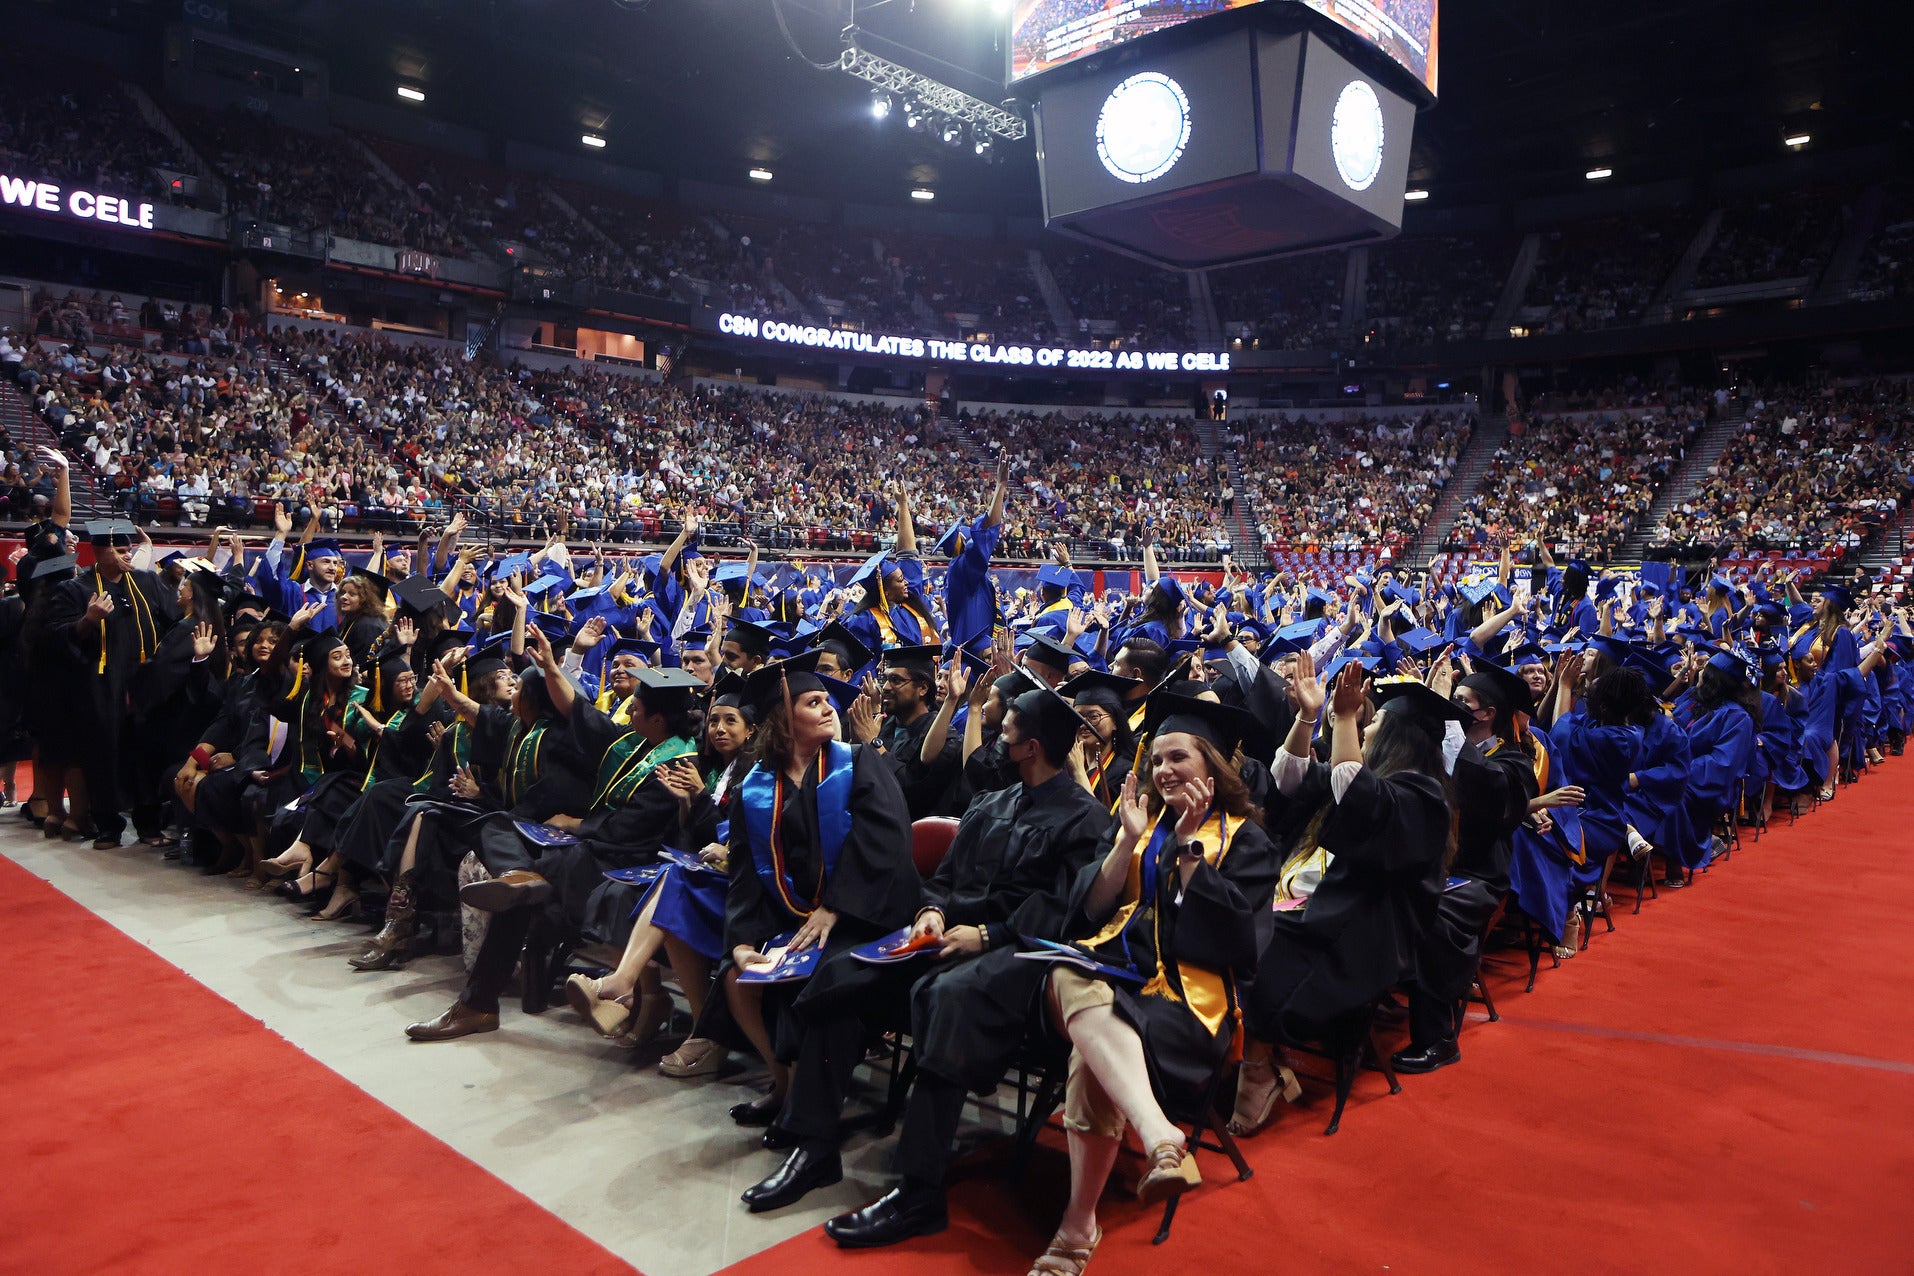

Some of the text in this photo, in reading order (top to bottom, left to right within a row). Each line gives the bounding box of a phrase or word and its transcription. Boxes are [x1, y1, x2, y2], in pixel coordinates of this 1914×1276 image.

[0, 174, 61, 212] WE
[718, 312, 759, 338] CSN
[761, 320, 925, 358] CONGRATULATES
[926, 340, 968, 361] THE
[969, 343, 1034, 366] CLASS
[1036, 347, 1065, 367] OF
[1067, 349, 1114, 369] 2022
[1115, 351, 1144, 370] AS
[1146, 351, 1179, 370] WE
